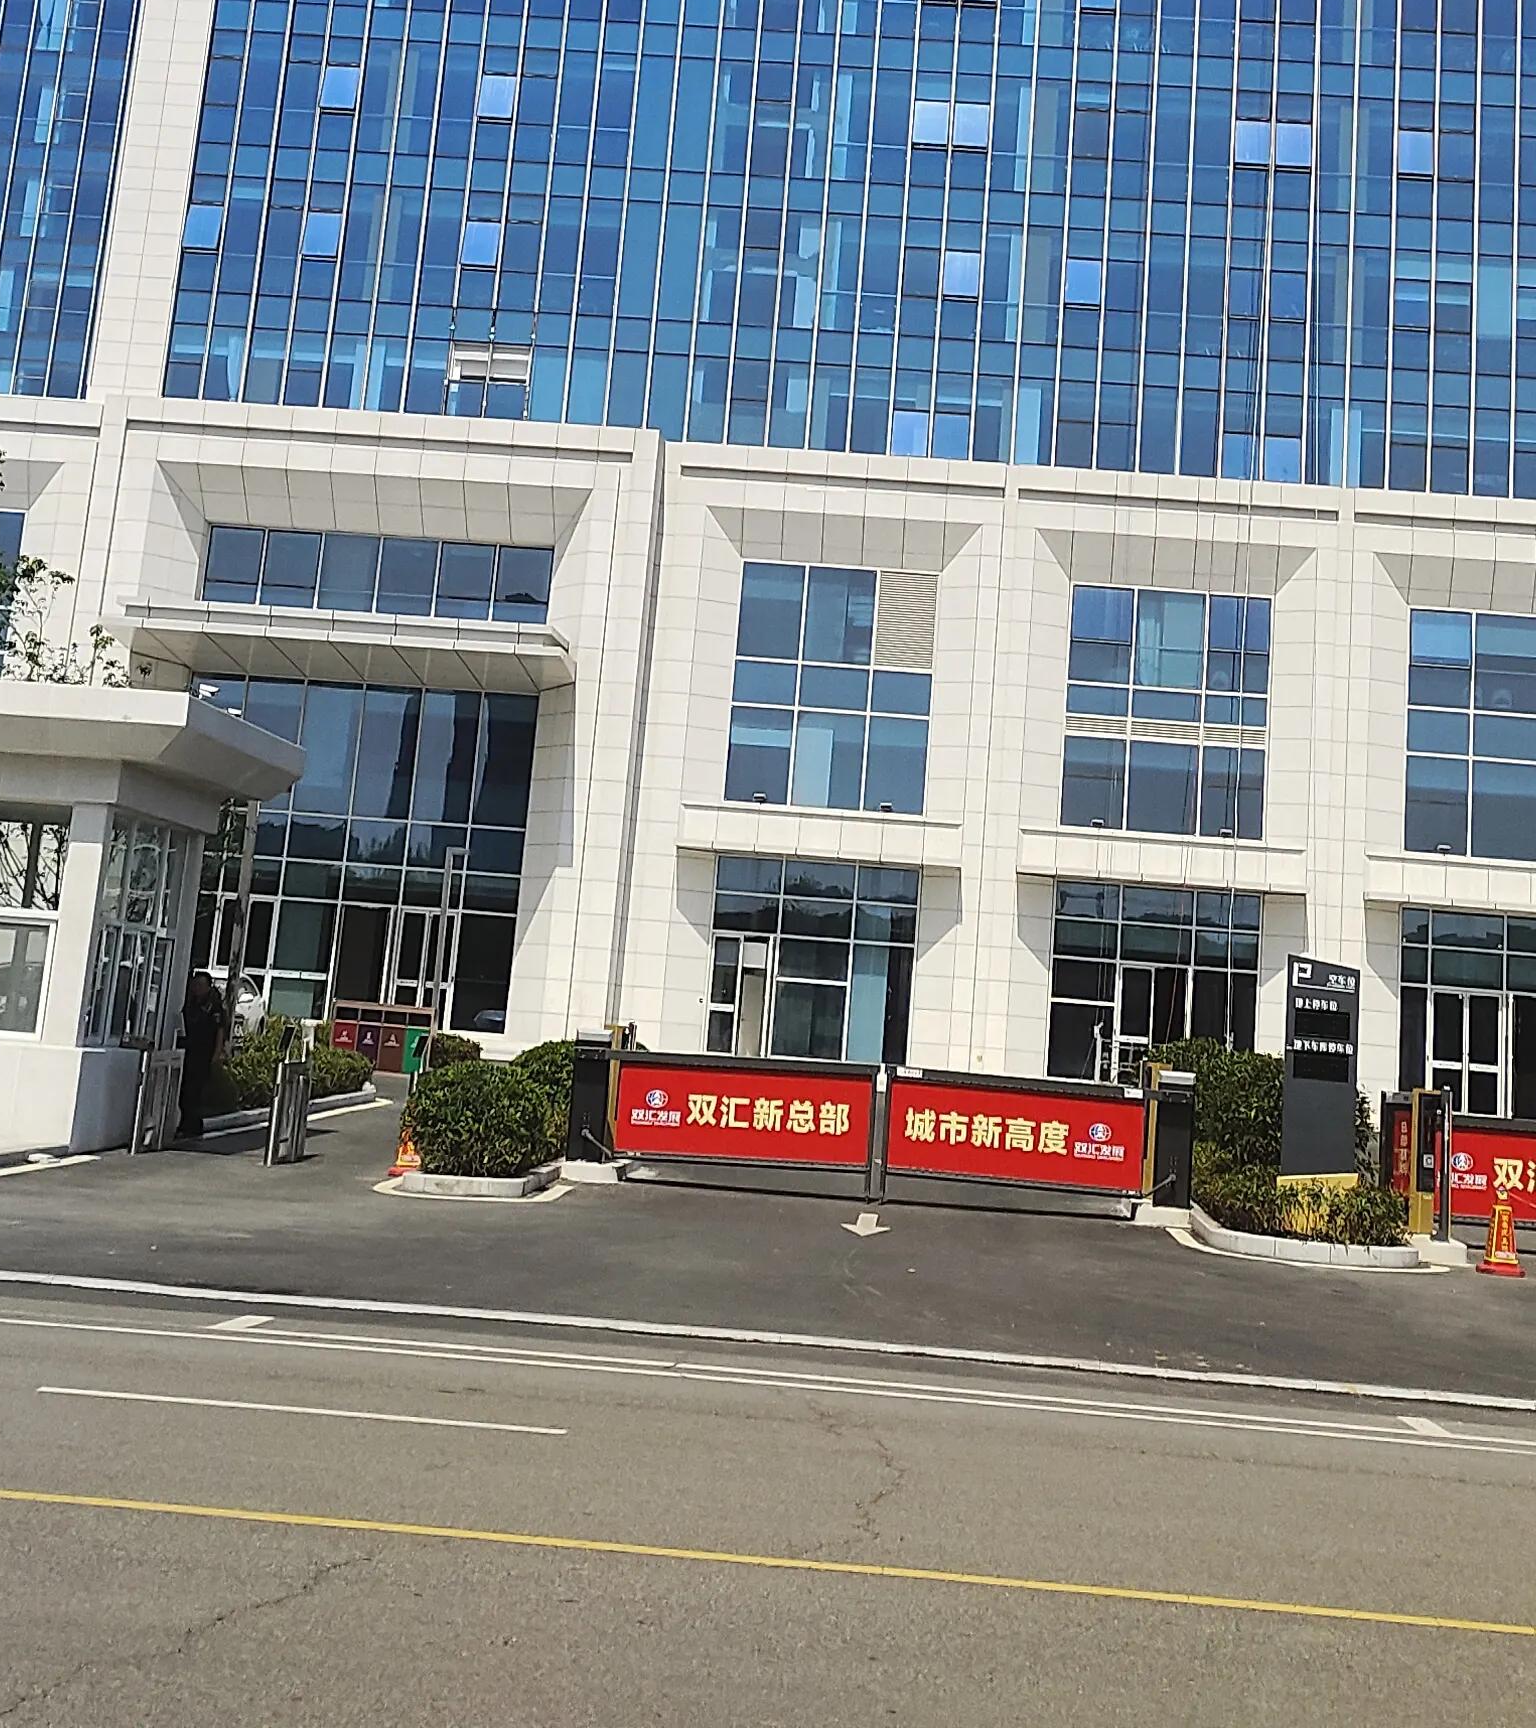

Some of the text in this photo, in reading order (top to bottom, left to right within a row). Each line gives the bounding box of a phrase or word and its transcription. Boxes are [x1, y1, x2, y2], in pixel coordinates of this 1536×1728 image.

[686, 1093, 851, 1136] 双汇新总部
[904, 1106, 1070, 1156] 城市新高度
